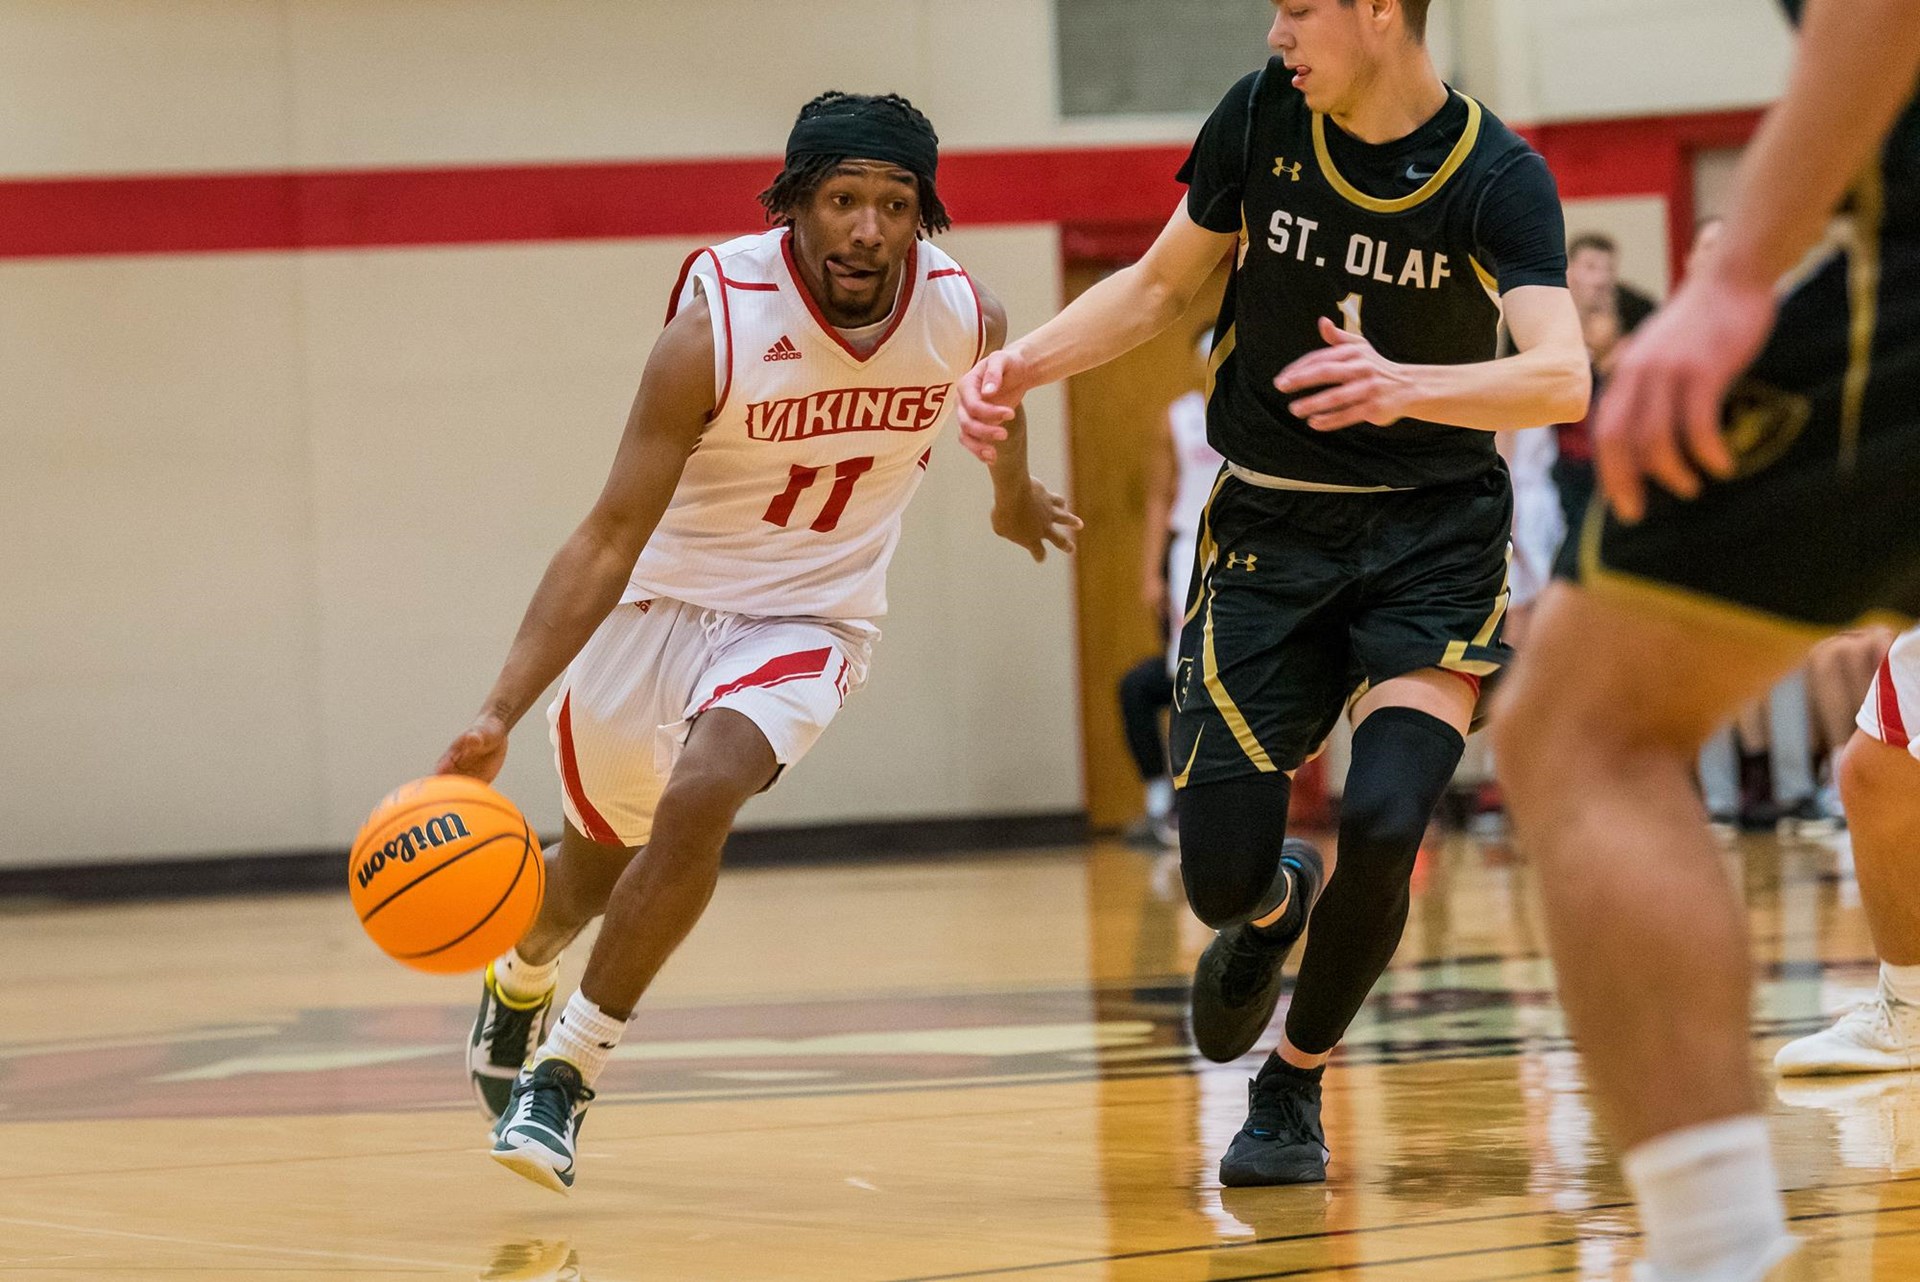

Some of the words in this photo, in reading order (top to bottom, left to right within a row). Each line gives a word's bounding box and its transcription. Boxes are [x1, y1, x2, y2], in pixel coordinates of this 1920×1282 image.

[1267, 209, 1325, 267] ST.
[1344, 232, 1451, 289] OLAF
[763, 351, 802, 362] adidas
[747, 384, 951, 441] VIKINGS
[761, 456, 875, 533] 11
[356, 811, 471, 889] Wilson
